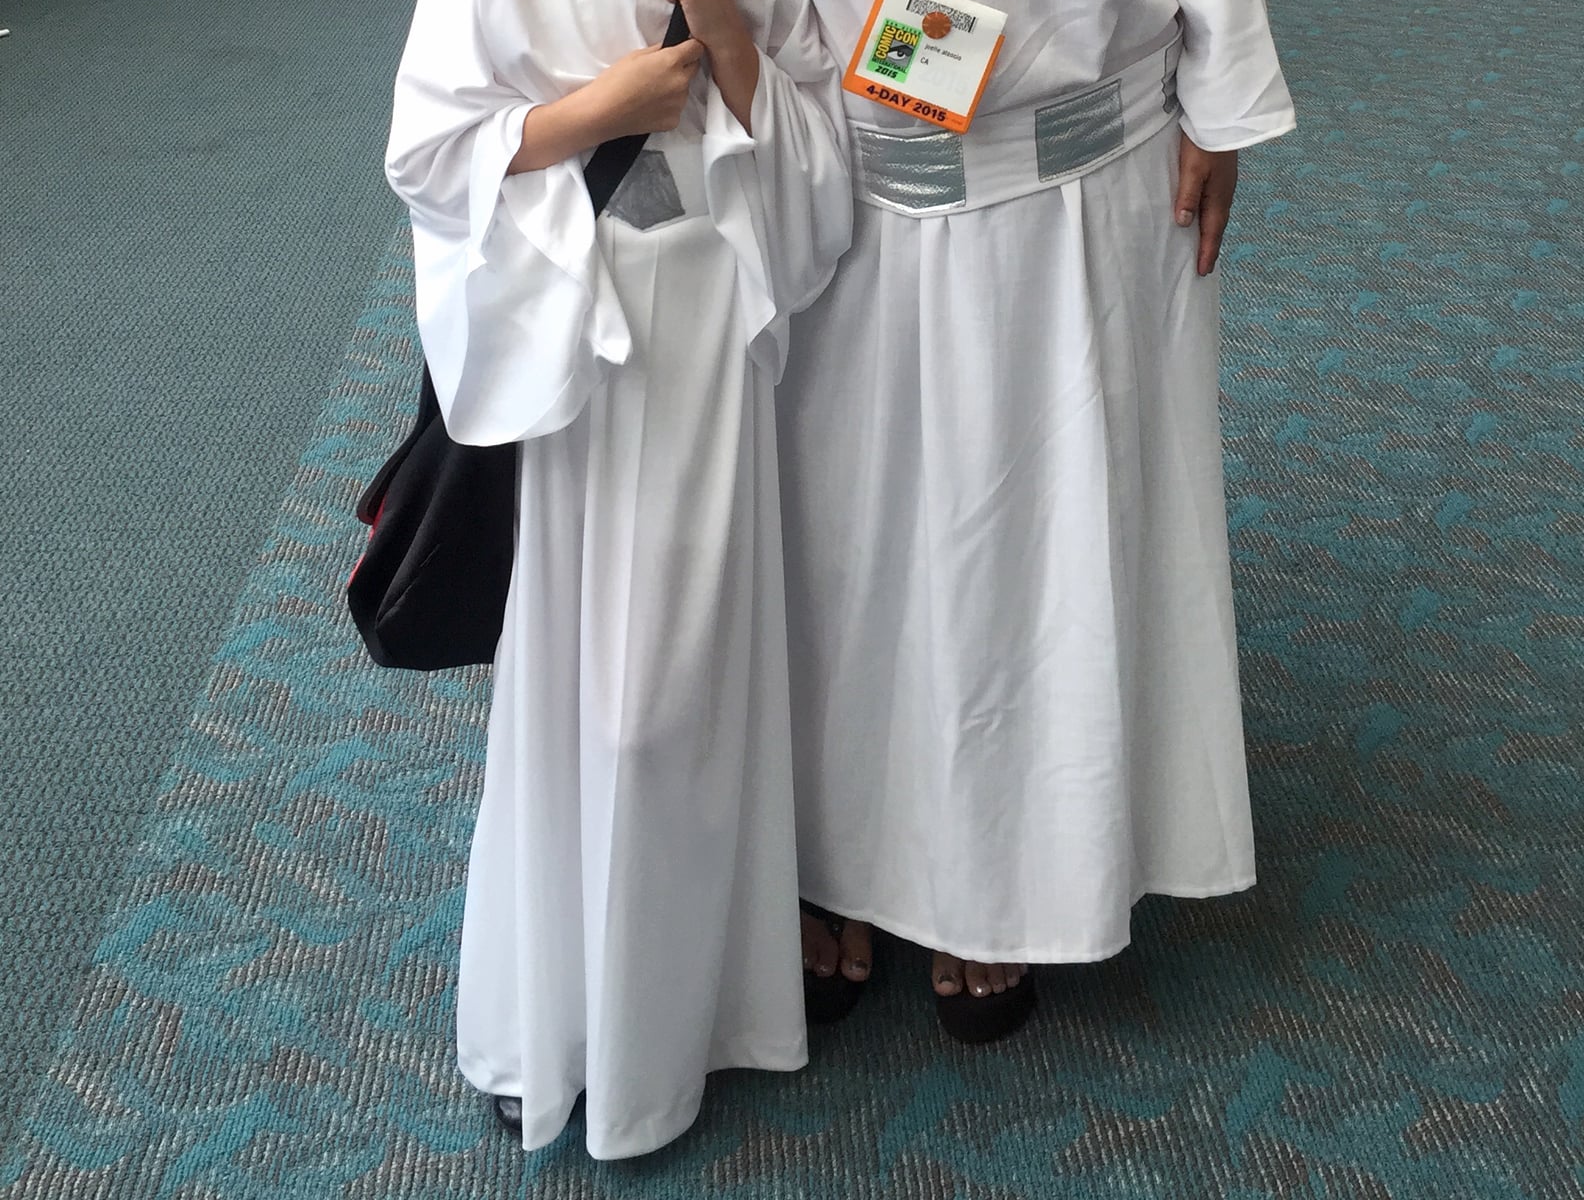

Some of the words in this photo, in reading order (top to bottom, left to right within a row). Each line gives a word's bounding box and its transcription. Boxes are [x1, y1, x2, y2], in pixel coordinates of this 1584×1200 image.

[875, 25, 897, 59] COMIC
[895, 30, 919, 46] CON
[874, 65, 899, 79] 2015
[920, 57, 929, 65] CA
[866, 84, 911, 108] 4-DAY
[913, 102, 947, 122] 2015
